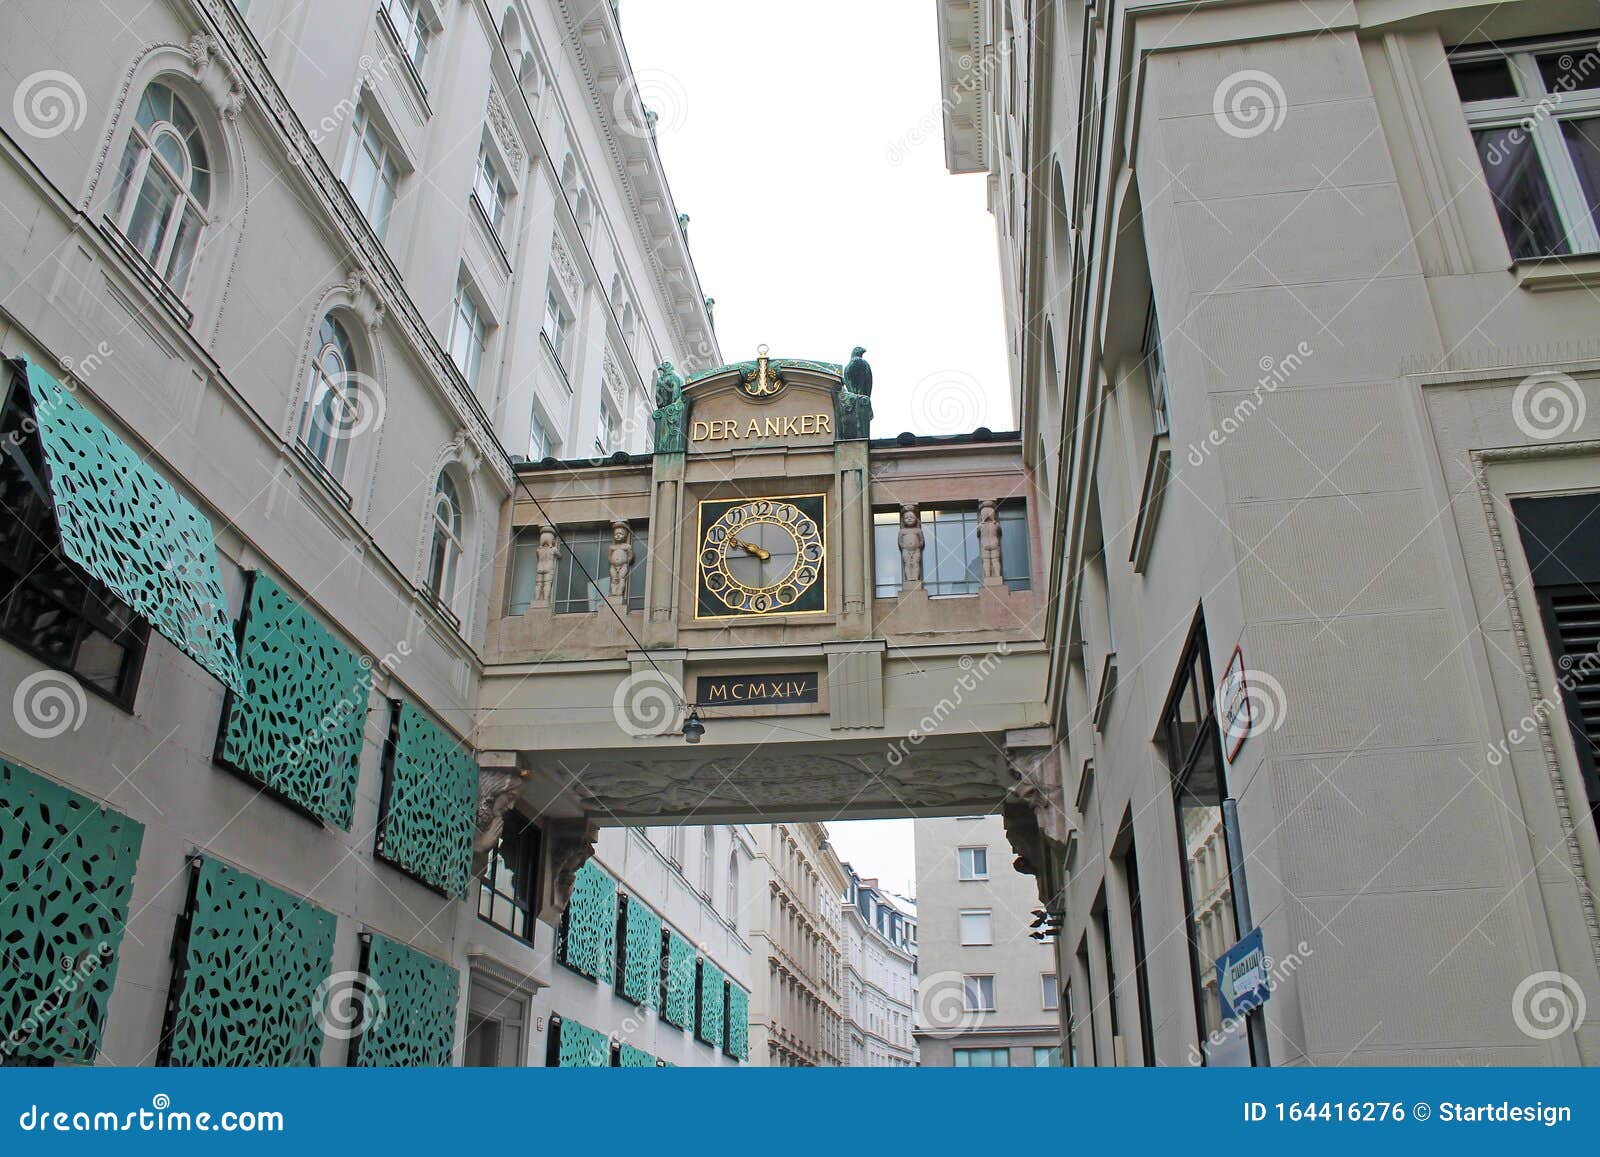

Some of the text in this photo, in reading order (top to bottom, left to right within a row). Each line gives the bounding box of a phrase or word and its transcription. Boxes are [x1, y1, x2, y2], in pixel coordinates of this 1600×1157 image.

[692, 414, 832, 442] DER ANKER
[756, 501, 769, 516] 12
[709, 527, 726, 542] 10
[801, 521, 813, 536] 2
[807, 545, 819, 561] 3
[799, 568, 815, 584] 4
[755, 595, 766, 611] 6
[708, 681, 806, 701] MCMXIV
